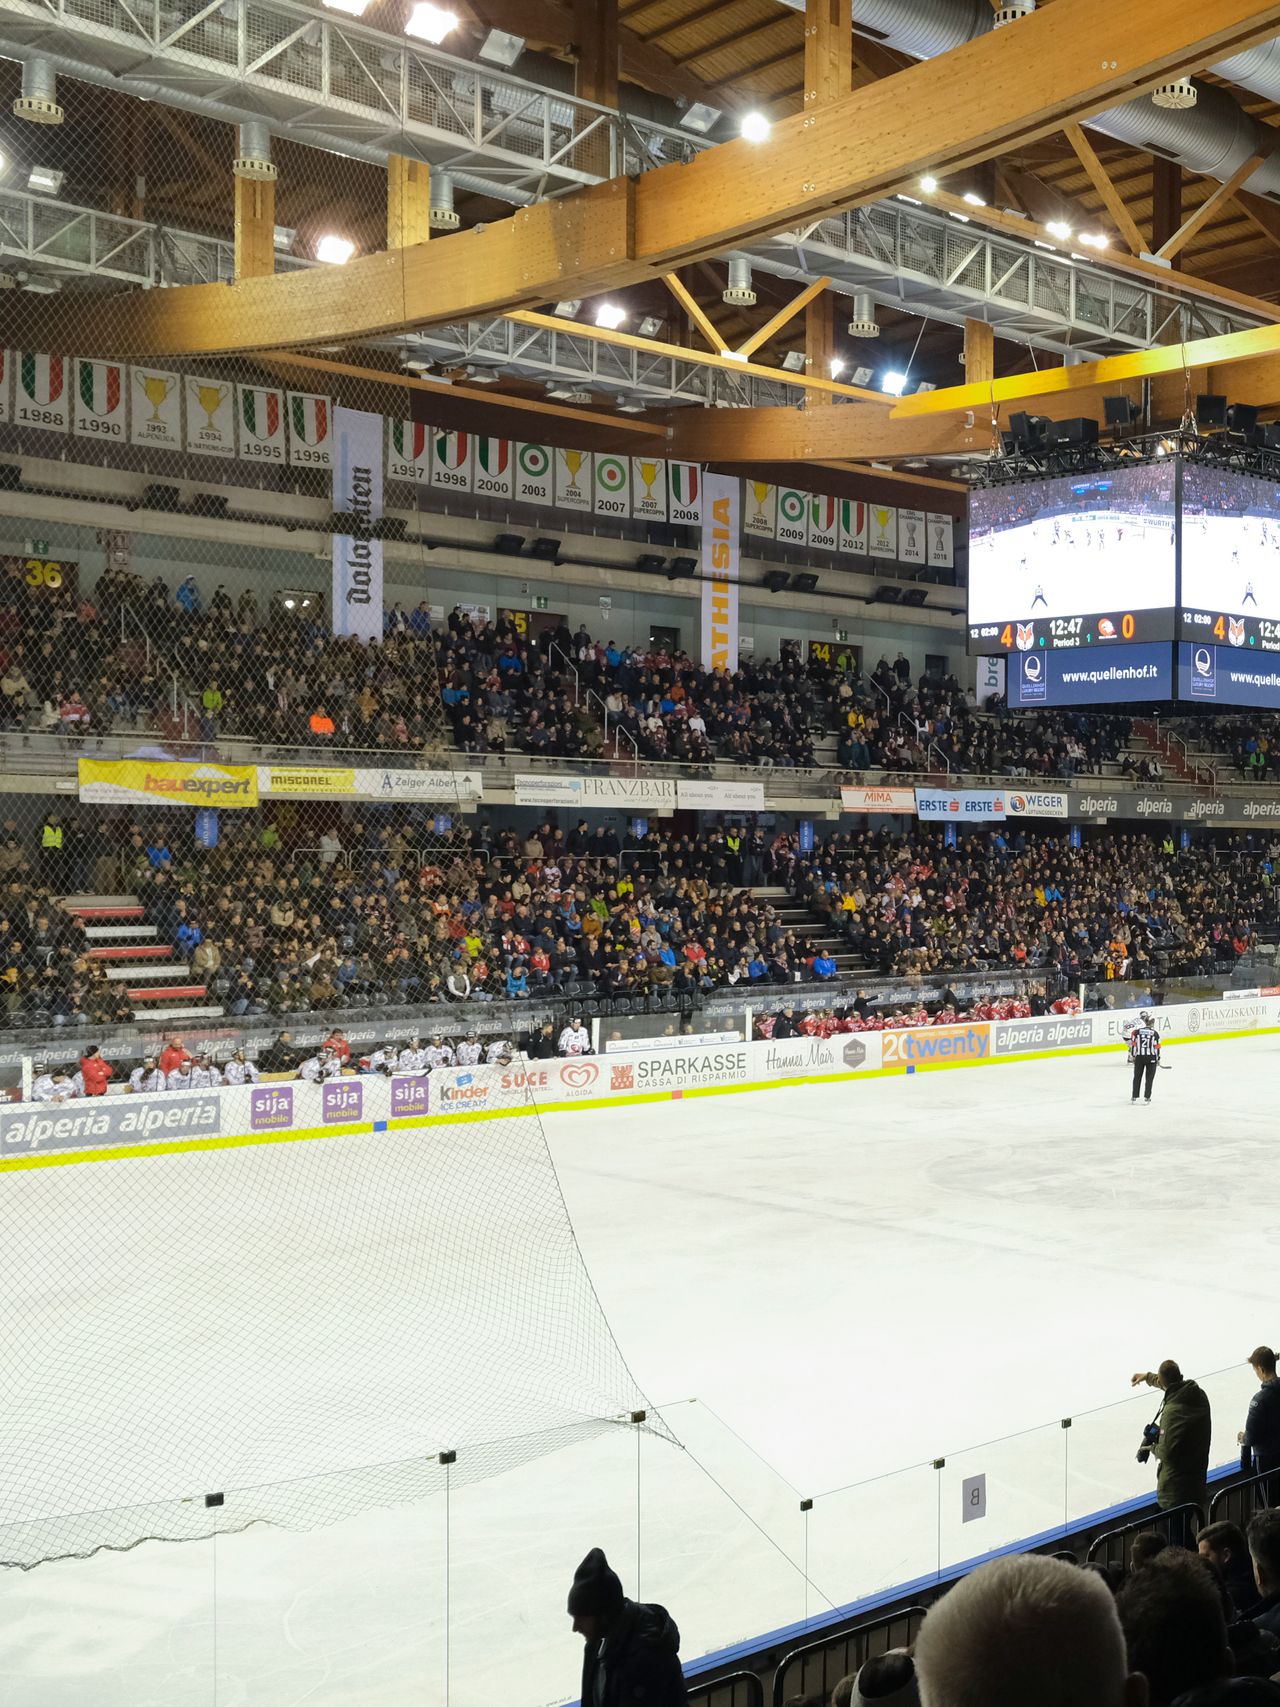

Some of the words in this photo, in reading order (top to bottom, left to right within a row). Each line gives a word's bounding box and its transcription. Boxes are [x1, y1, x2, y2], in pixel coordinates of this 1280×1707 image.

[19, 408, 64, 426] 1988
[79, 418, 121, 435] 1990
[244, 443, 282, 458] 1995
[294, 450, 330, 464] 1996
[392, 464, 424, 478] 1997
[434, 472, 467, 486] 1998
[478, 479, 508, 494] 2000
[522, 484, 546, 497] 2003
[566, 489, 581, 498] 2004
[598, 500, 626, 512] 2007
[641, 500, 657, 509] 2007
[673, 509, 699, 521] 2008
[752, 516, 768, 525] 2008
[780, 528, 804, 540] 2009
[811, 534, 834, 546] 2009
[842, 539, 864, 550] 2012
[26, 560, 62, 588] 36
[712, 497, 730, 672] ATHESIA
[1183, 613, 1192, 623] 12
[970, 629, 979, 638] 12
[1050, 618, 1083, 635] 12:47
[1122, 614, 1134, 639] 0
[1214, 616, 1225, 640] 4
[1000, 624, 1013, 647] 4
[1054, 639, 1073, 648] Period
[1074, 638, 1080, 646] 3
[1262, 640, 1280, 650] Period
[1062, 665, 1158, 683] www.quellenhof.it
[144, 774, 250, 798] bauexpert
[583, 779, 672, 796] FRANZBAR
[920, 800, 947, 811] ERSTE
[965, 801, 992, 812] ERSTE
[1026, 795, 1062, 807] WEGER
[1080, 796, 1117, 815] alperia
[1136, 797, 1172, 816] alperia
[1190, 800, 1225, 818] alperia
[1202, 1006, 1267, 1020] FRANZISKANER
[998, 1026, 1042, 1050] alperia
[1047, 1021, 1091, 1044] alperia
[766, 1048, 803, 1070] Hannes
[806, 1044, 834, 1066] Mair
[638, 1053, 747, 1078] SPARKASSE
[637, 1078, 672, 1089] CASSA
[677, 1076, 687, 1084] DI
[691, 1071, 747, 1083] RISPARMIO
[326, 1086, 358, 1108] sija
[395, 1081, 425, 1103] sija
[440, 1084, 489, 1101] Kinder
[566, 1088, 593, 1097] ALGIDA
[255, 1091, 288, 1114] sija
[395, 1102, 425, 1113] mobile
[441, 1100, 458, 1110] ICE
[459, 1099, 487, 1110] CREAM
[255, 1114, 288, 1125] mobile
[326, 1108, 358, 1119] mobile
[5, 1110, 111, 1148] alperia
[119, 1101, 217, 1137] alperia
